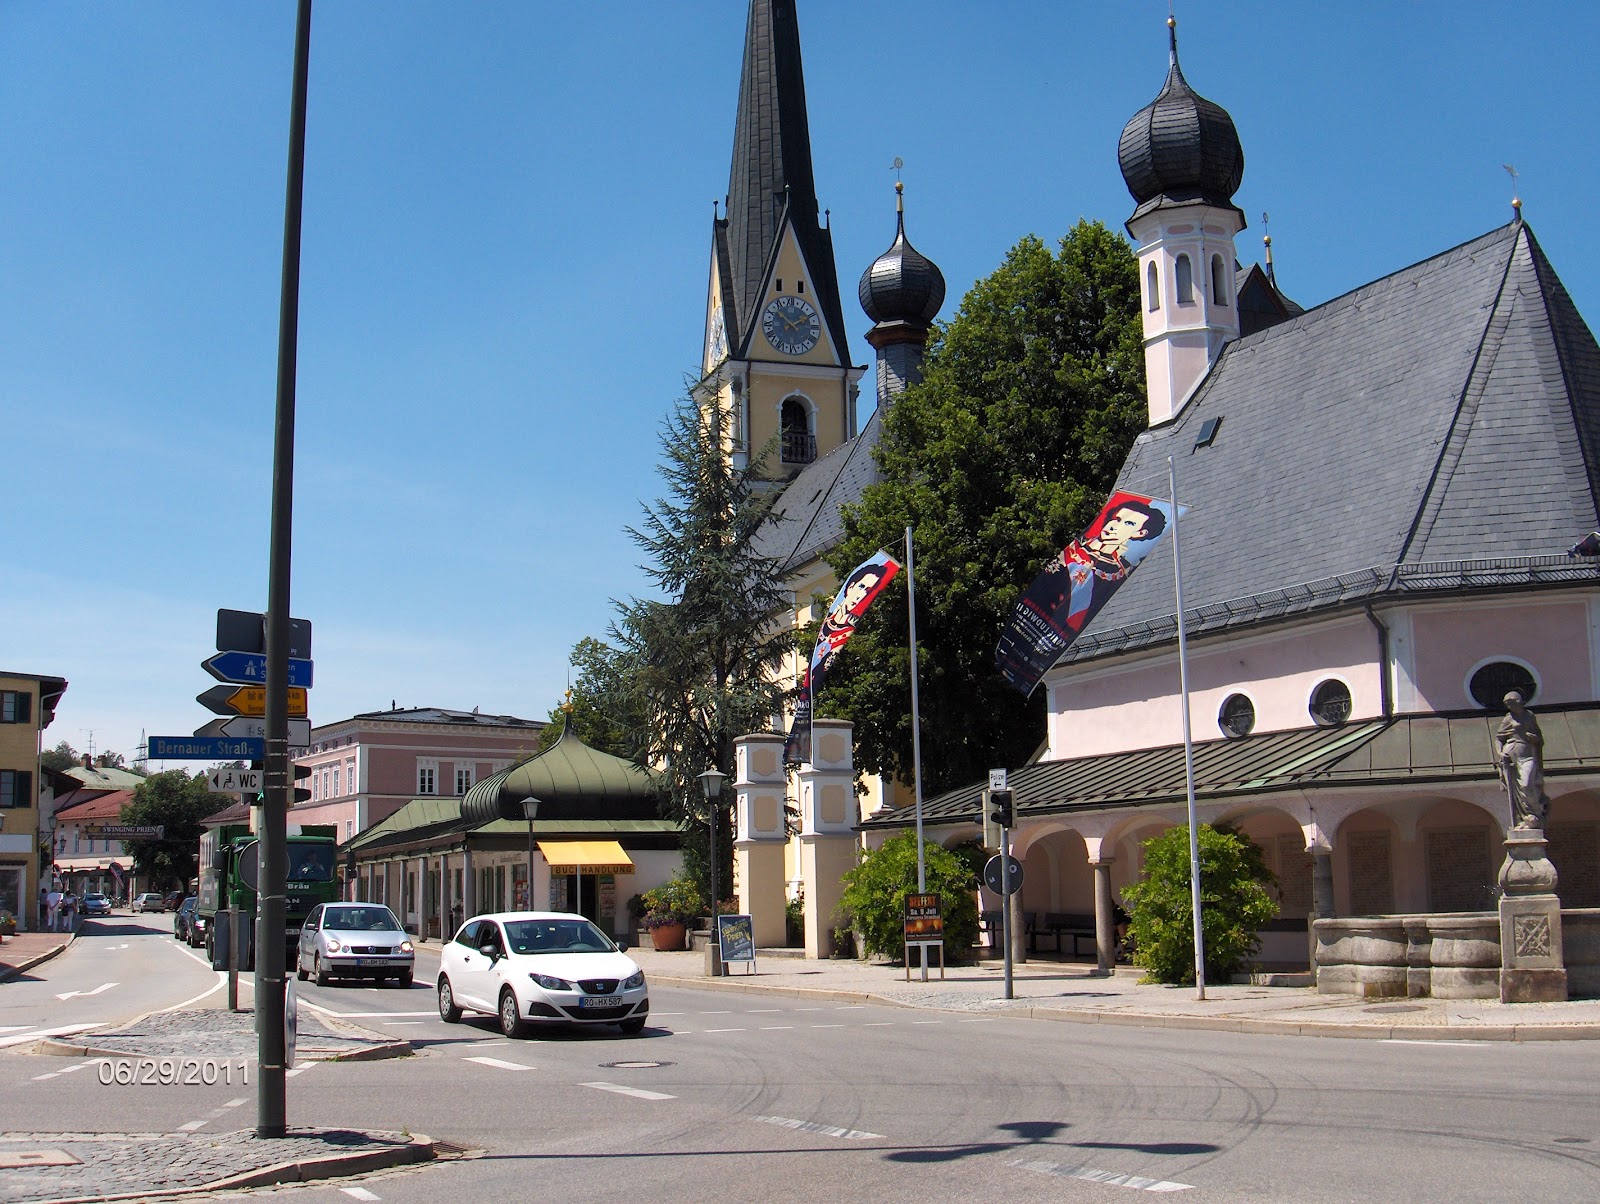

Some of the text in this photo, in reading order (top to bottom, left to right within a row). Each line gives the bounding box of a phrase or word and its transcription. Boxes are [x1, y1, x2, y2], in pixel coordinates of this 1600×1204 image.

[786, 298, 794, 306] XII
[158, 741, 254, 755] Bernauer Straße
[240, 775, 256, 787] WC
[556, 866, 632, 874] BUCHANDLUNG
